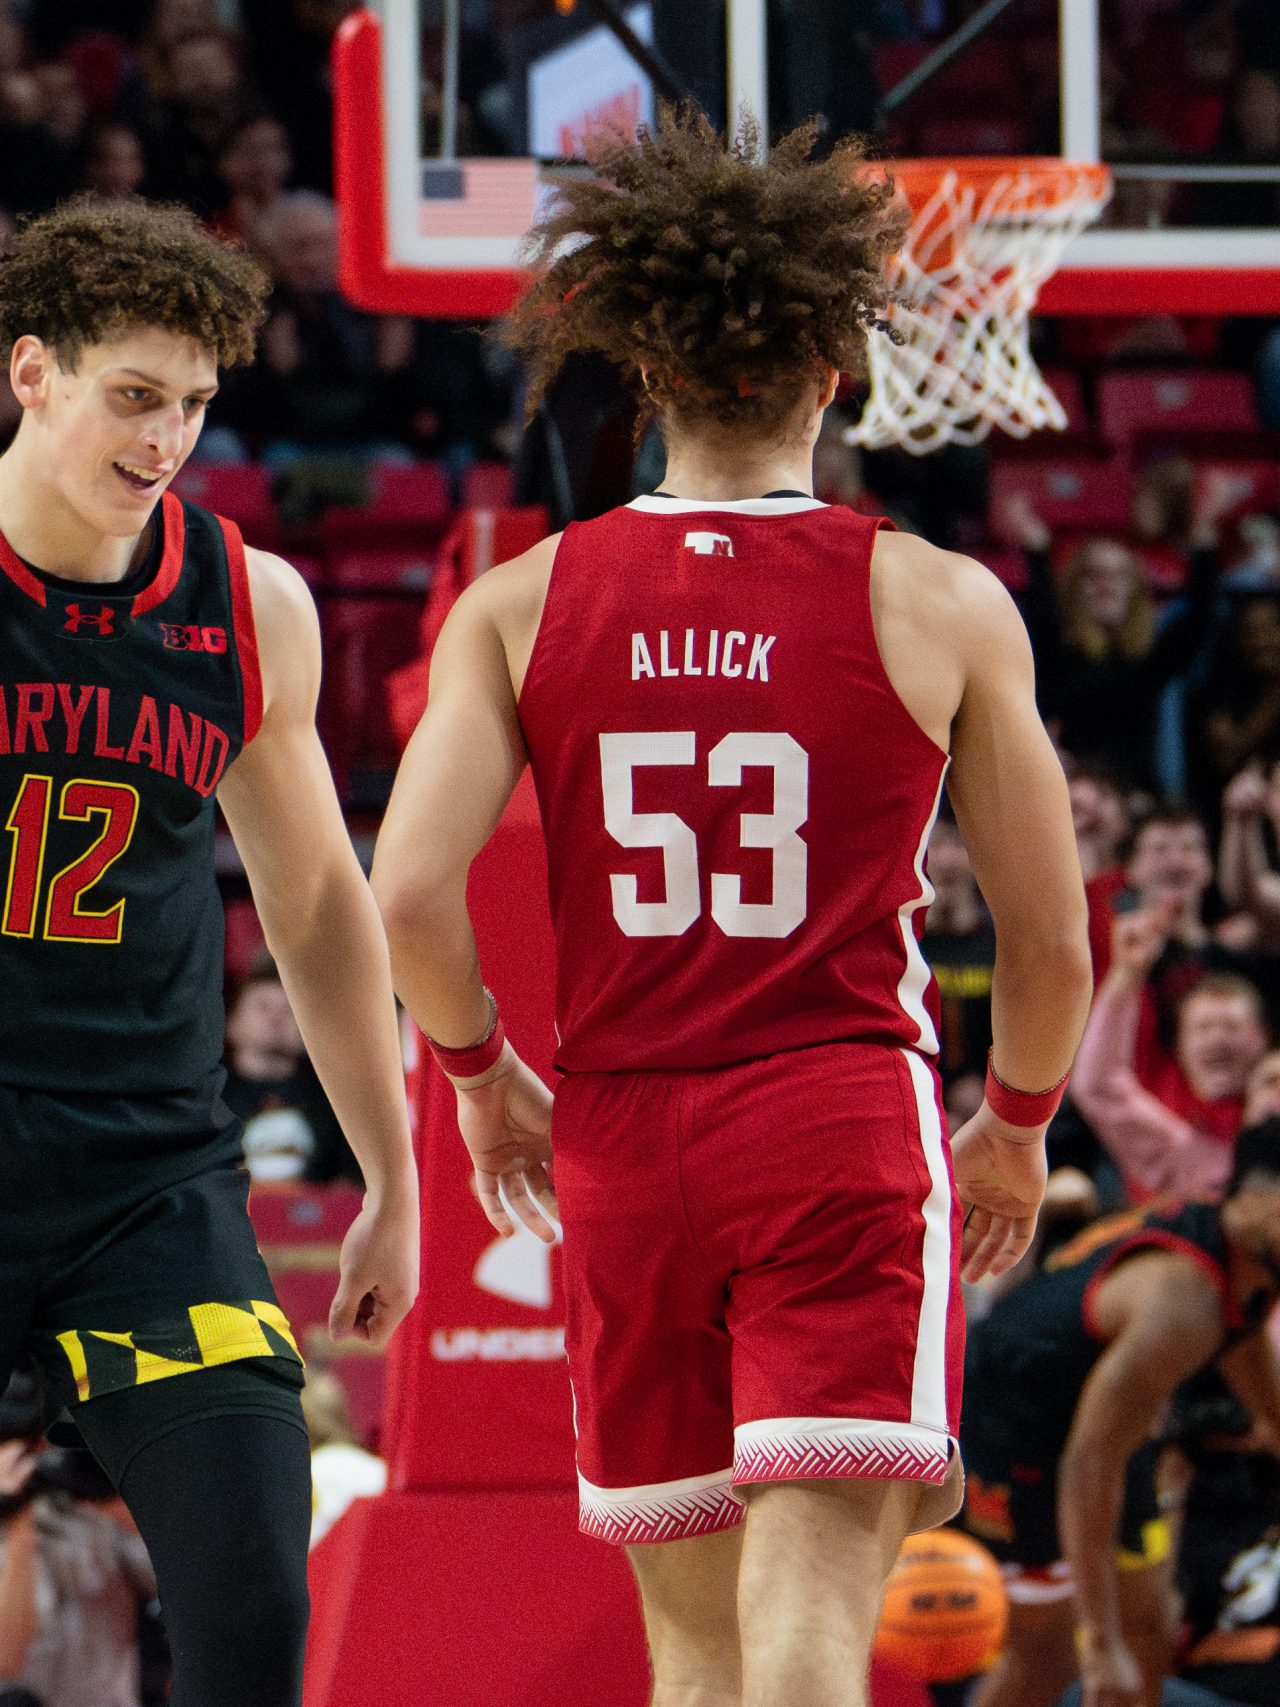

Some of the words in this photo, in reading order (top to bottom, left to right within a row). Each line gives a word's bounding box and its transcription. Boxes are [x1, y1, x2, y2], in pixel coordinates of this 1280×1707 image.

[631, 628, 777, 683] ALLICK
[1, 773, 140, 945] 12
[598, 730, 810, 939] 53
